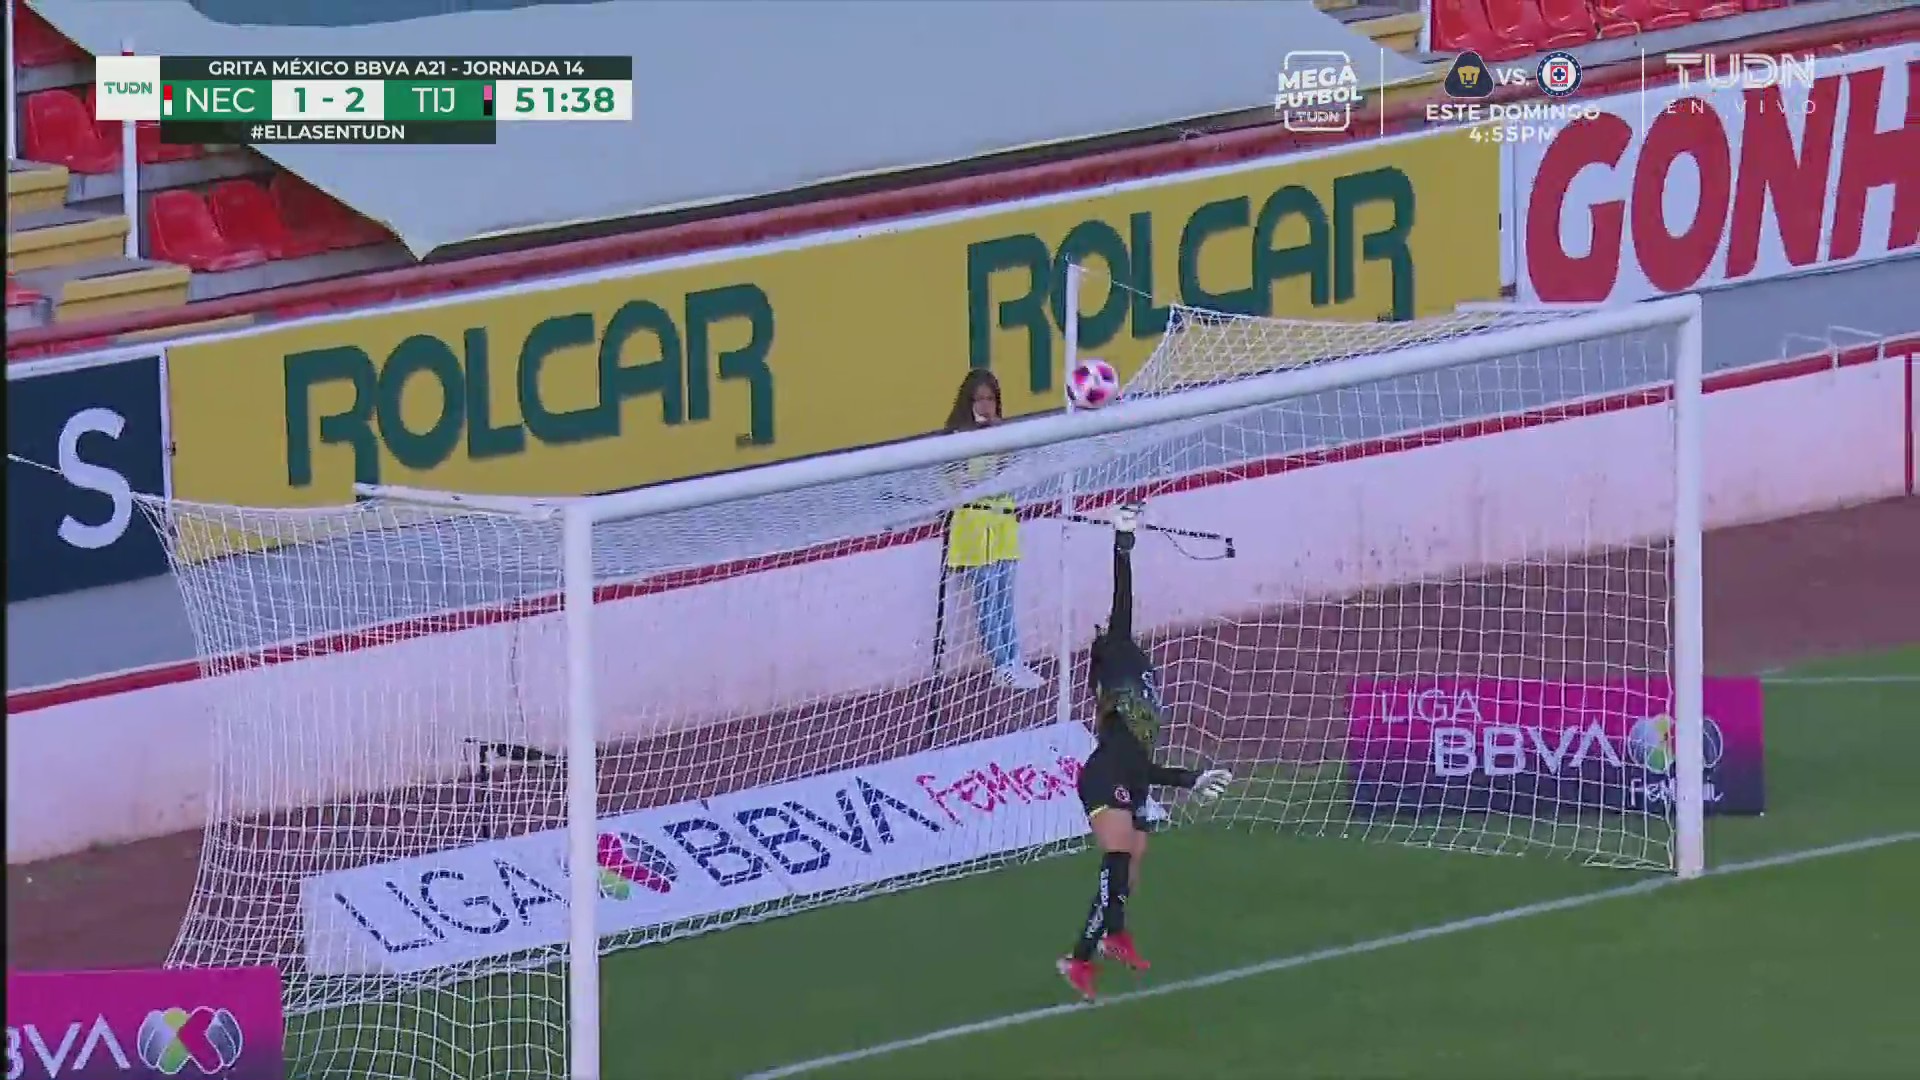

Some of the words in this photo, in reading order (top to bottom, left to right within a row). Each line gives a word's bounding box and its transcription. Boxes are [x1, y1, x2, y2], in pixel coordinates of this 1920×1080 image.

[967, 166, 1415, 393] ROLCAR
[1526, 62, 1920, 304] GONH
[284, 283, 775, 502] ROLCAR
[1382, 690, 1482, 723] LIGA
[1434, 715, 1622, 776] BBVA
[334, 857, 570, 953] LIGA
[663, 776, 943, 886] BBVA
